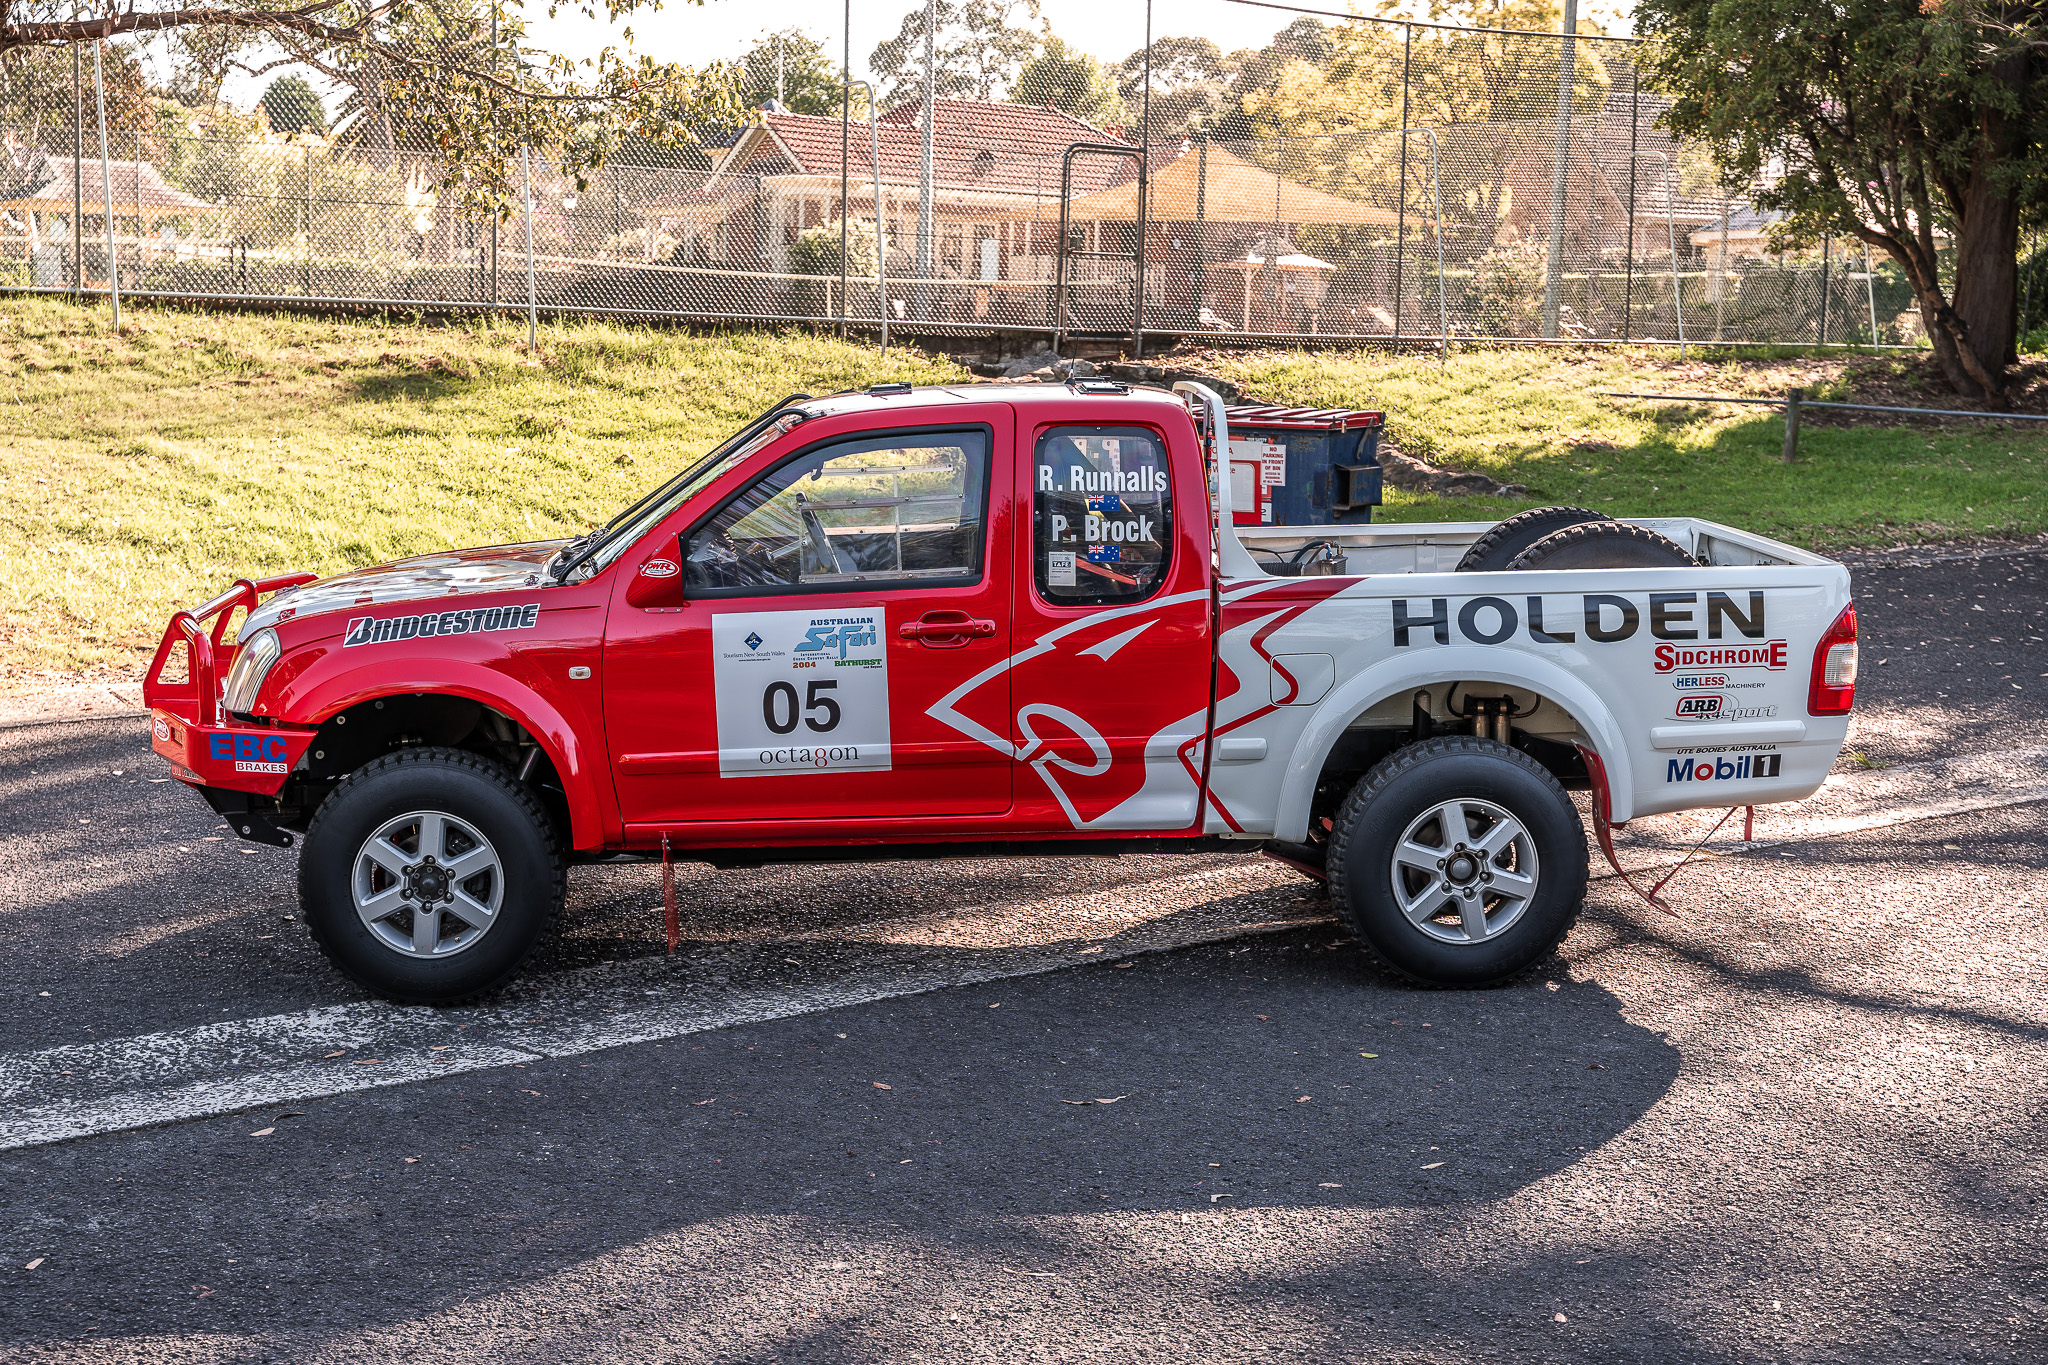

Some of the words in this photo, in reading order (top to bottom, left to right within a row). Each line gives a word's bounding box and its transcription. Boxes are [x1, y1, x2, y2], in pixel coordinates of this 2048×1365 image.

[1039, 465, 1063, 491] R.
[1070, 465, 1167, 492] Runnalls
[1052, 515, 1077, 542] P.
[1084, 515, 1155, 542] Brock
[643, 562, 674, 574] PWR
[343, 604, 540, 647] BRIDGESTONE
[810, 617, 873, 626] AUSTRALIAN
[1392, 591, 1764, 647] HOLDEN
[794, 625, 876, 660] Safari
[1654, 643, 1787, 671] SIDCHROME
[1676, 676, 1725, 687] HERLESS
[763, 680, 841, 735] 05
[1680, 699, 1719, 713] ARB
[209, 733, 287, 762] EBC
[759, 746, 860, 768] octagon
[1729, 744, 1776, 752] AUSTRALIA
[237, 762, 286, 773] BRAKES
[1667, 755, 1751, 783] Mobil
